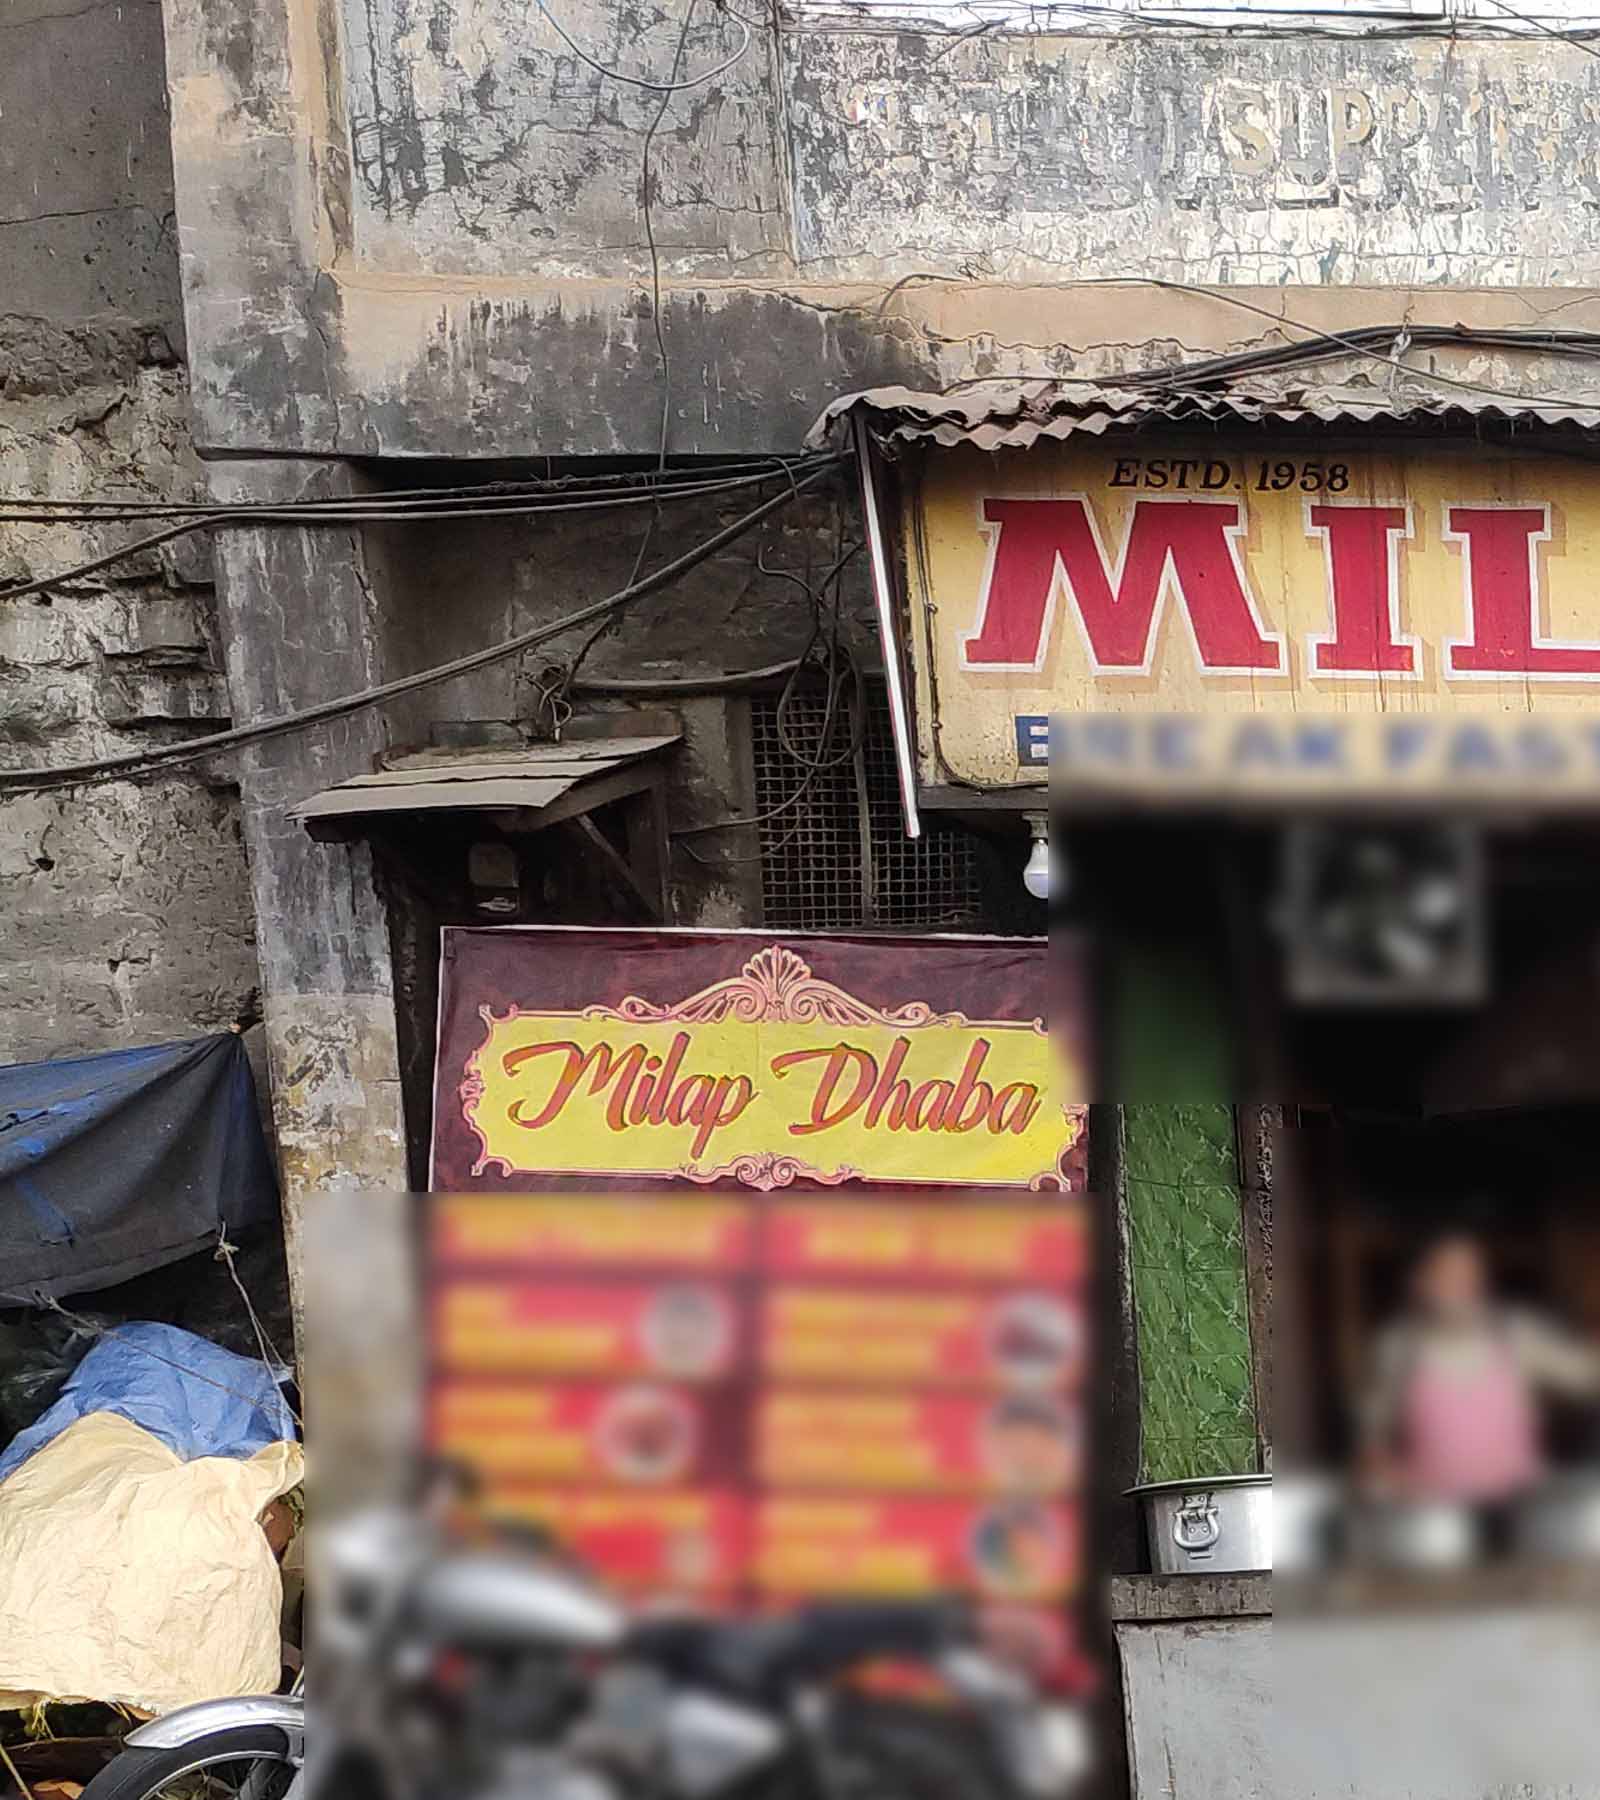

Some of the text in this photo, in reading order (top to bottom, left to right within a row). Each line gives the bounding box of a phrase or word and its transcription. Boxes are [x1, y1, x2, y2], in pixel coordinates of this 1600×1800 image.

[1108, 458, 1350, 492] ESTD. 1958
[503, 1031, 1044, 1160] Milap Dhaba
